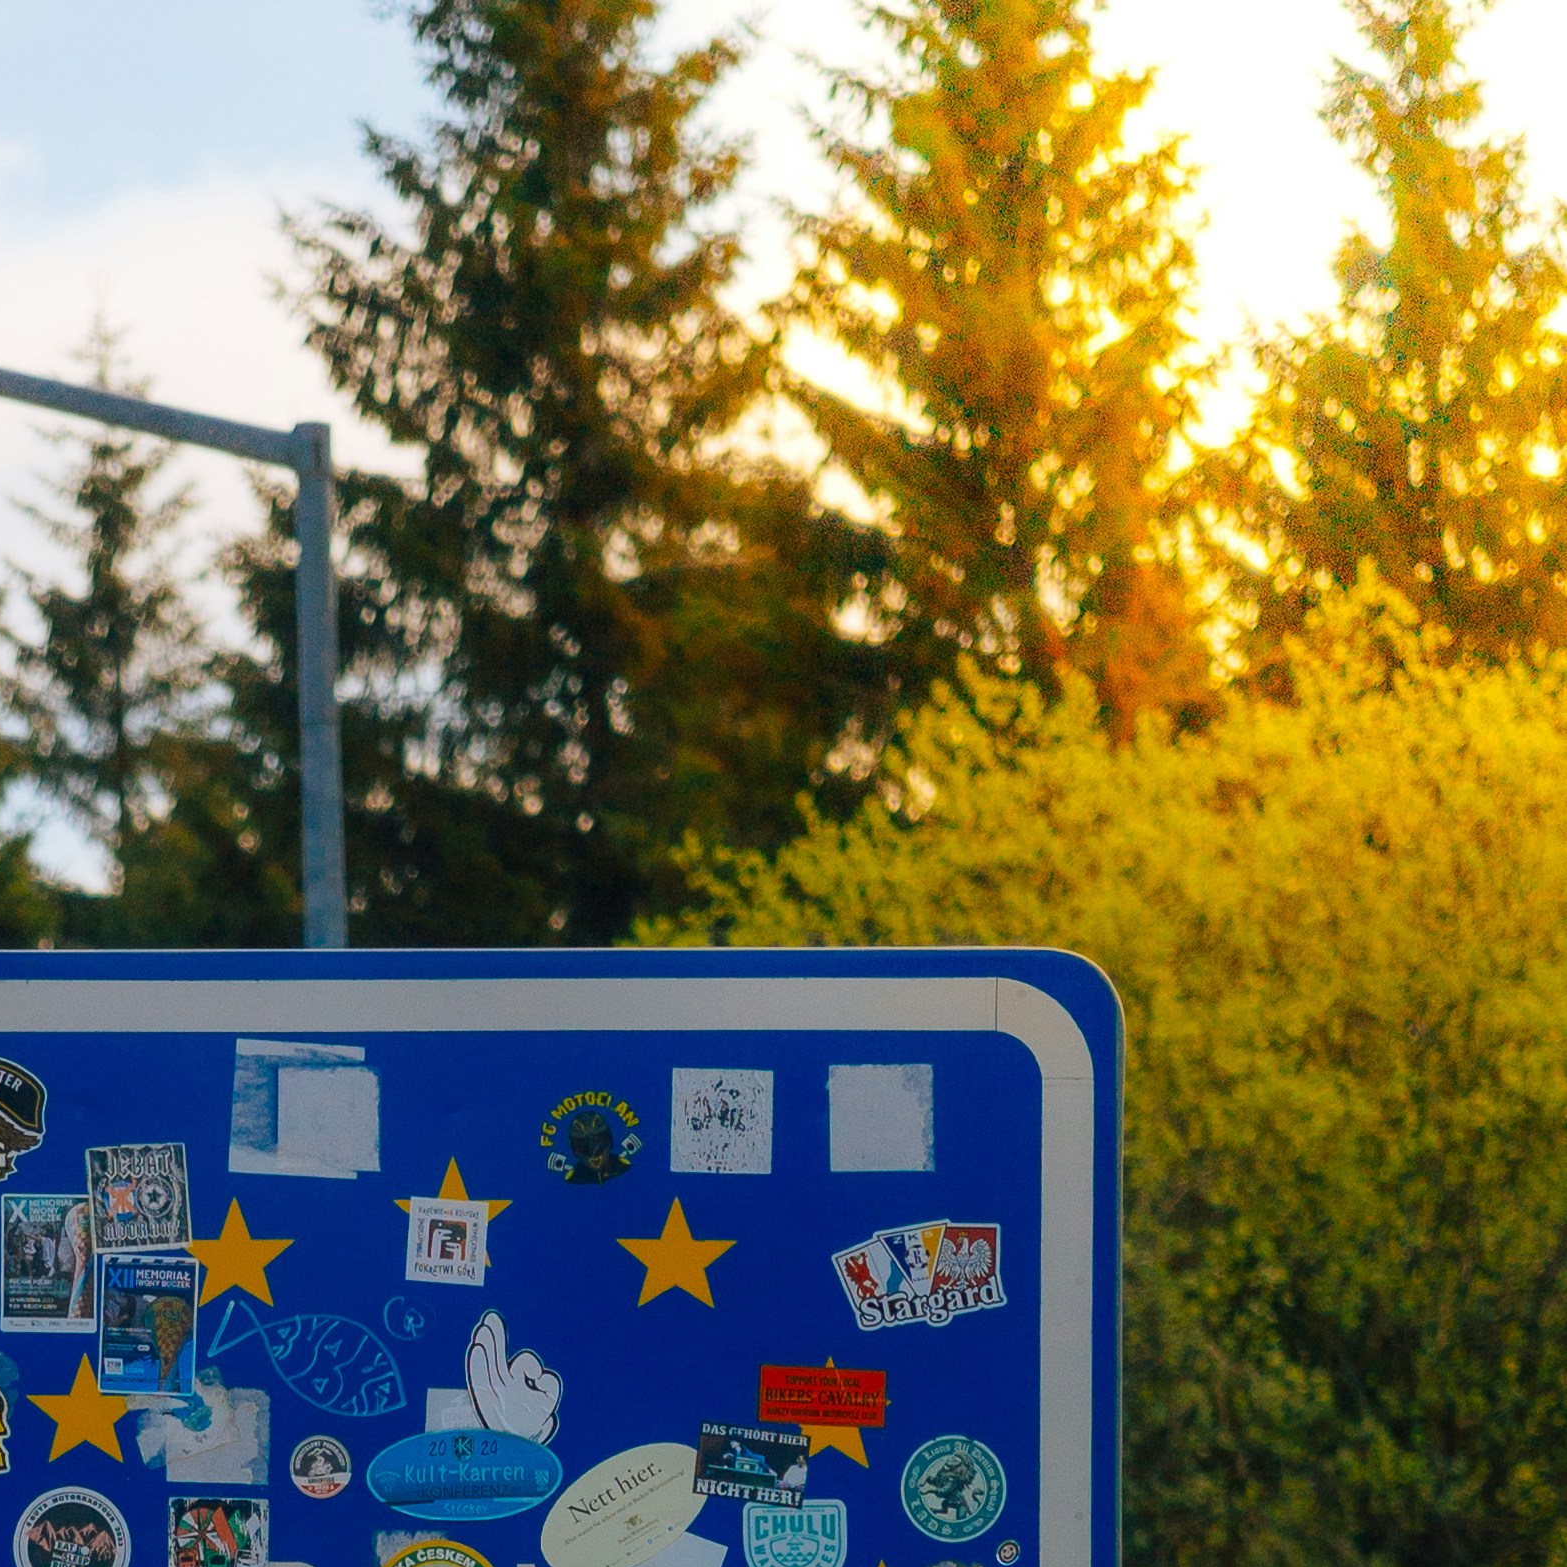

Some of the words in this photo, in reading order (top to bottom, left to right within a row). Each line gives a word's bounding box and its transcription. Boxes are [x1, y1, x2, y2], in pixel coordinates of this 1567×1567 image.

[9, 1200, 29, 1222] X
[108, 1268, 134, 1289] XII
[860, 1275, 1001, 1327] Stargard
[765, 1388, 813, 1403] BIKERS
[818, 1390, 882, 1407] CAVALRY
[702, 1423, 727, 1436] DAS
[779, 1433, 809, 1447] HIER
[404, 1462, 525, 1484] Kult-Karren
[567, 1488, 617, 1523] Nett
[614, 1462, 663, 1495] hier.
[696, 1479, 754, 1500] NICHT
[757, 1485, 803, 1507] HER!
[754, 1514, 836, 1541] CHULU
[56, 1542, 78, 1552] EAT
[63, 1552, 90, 1565] SLEEP
